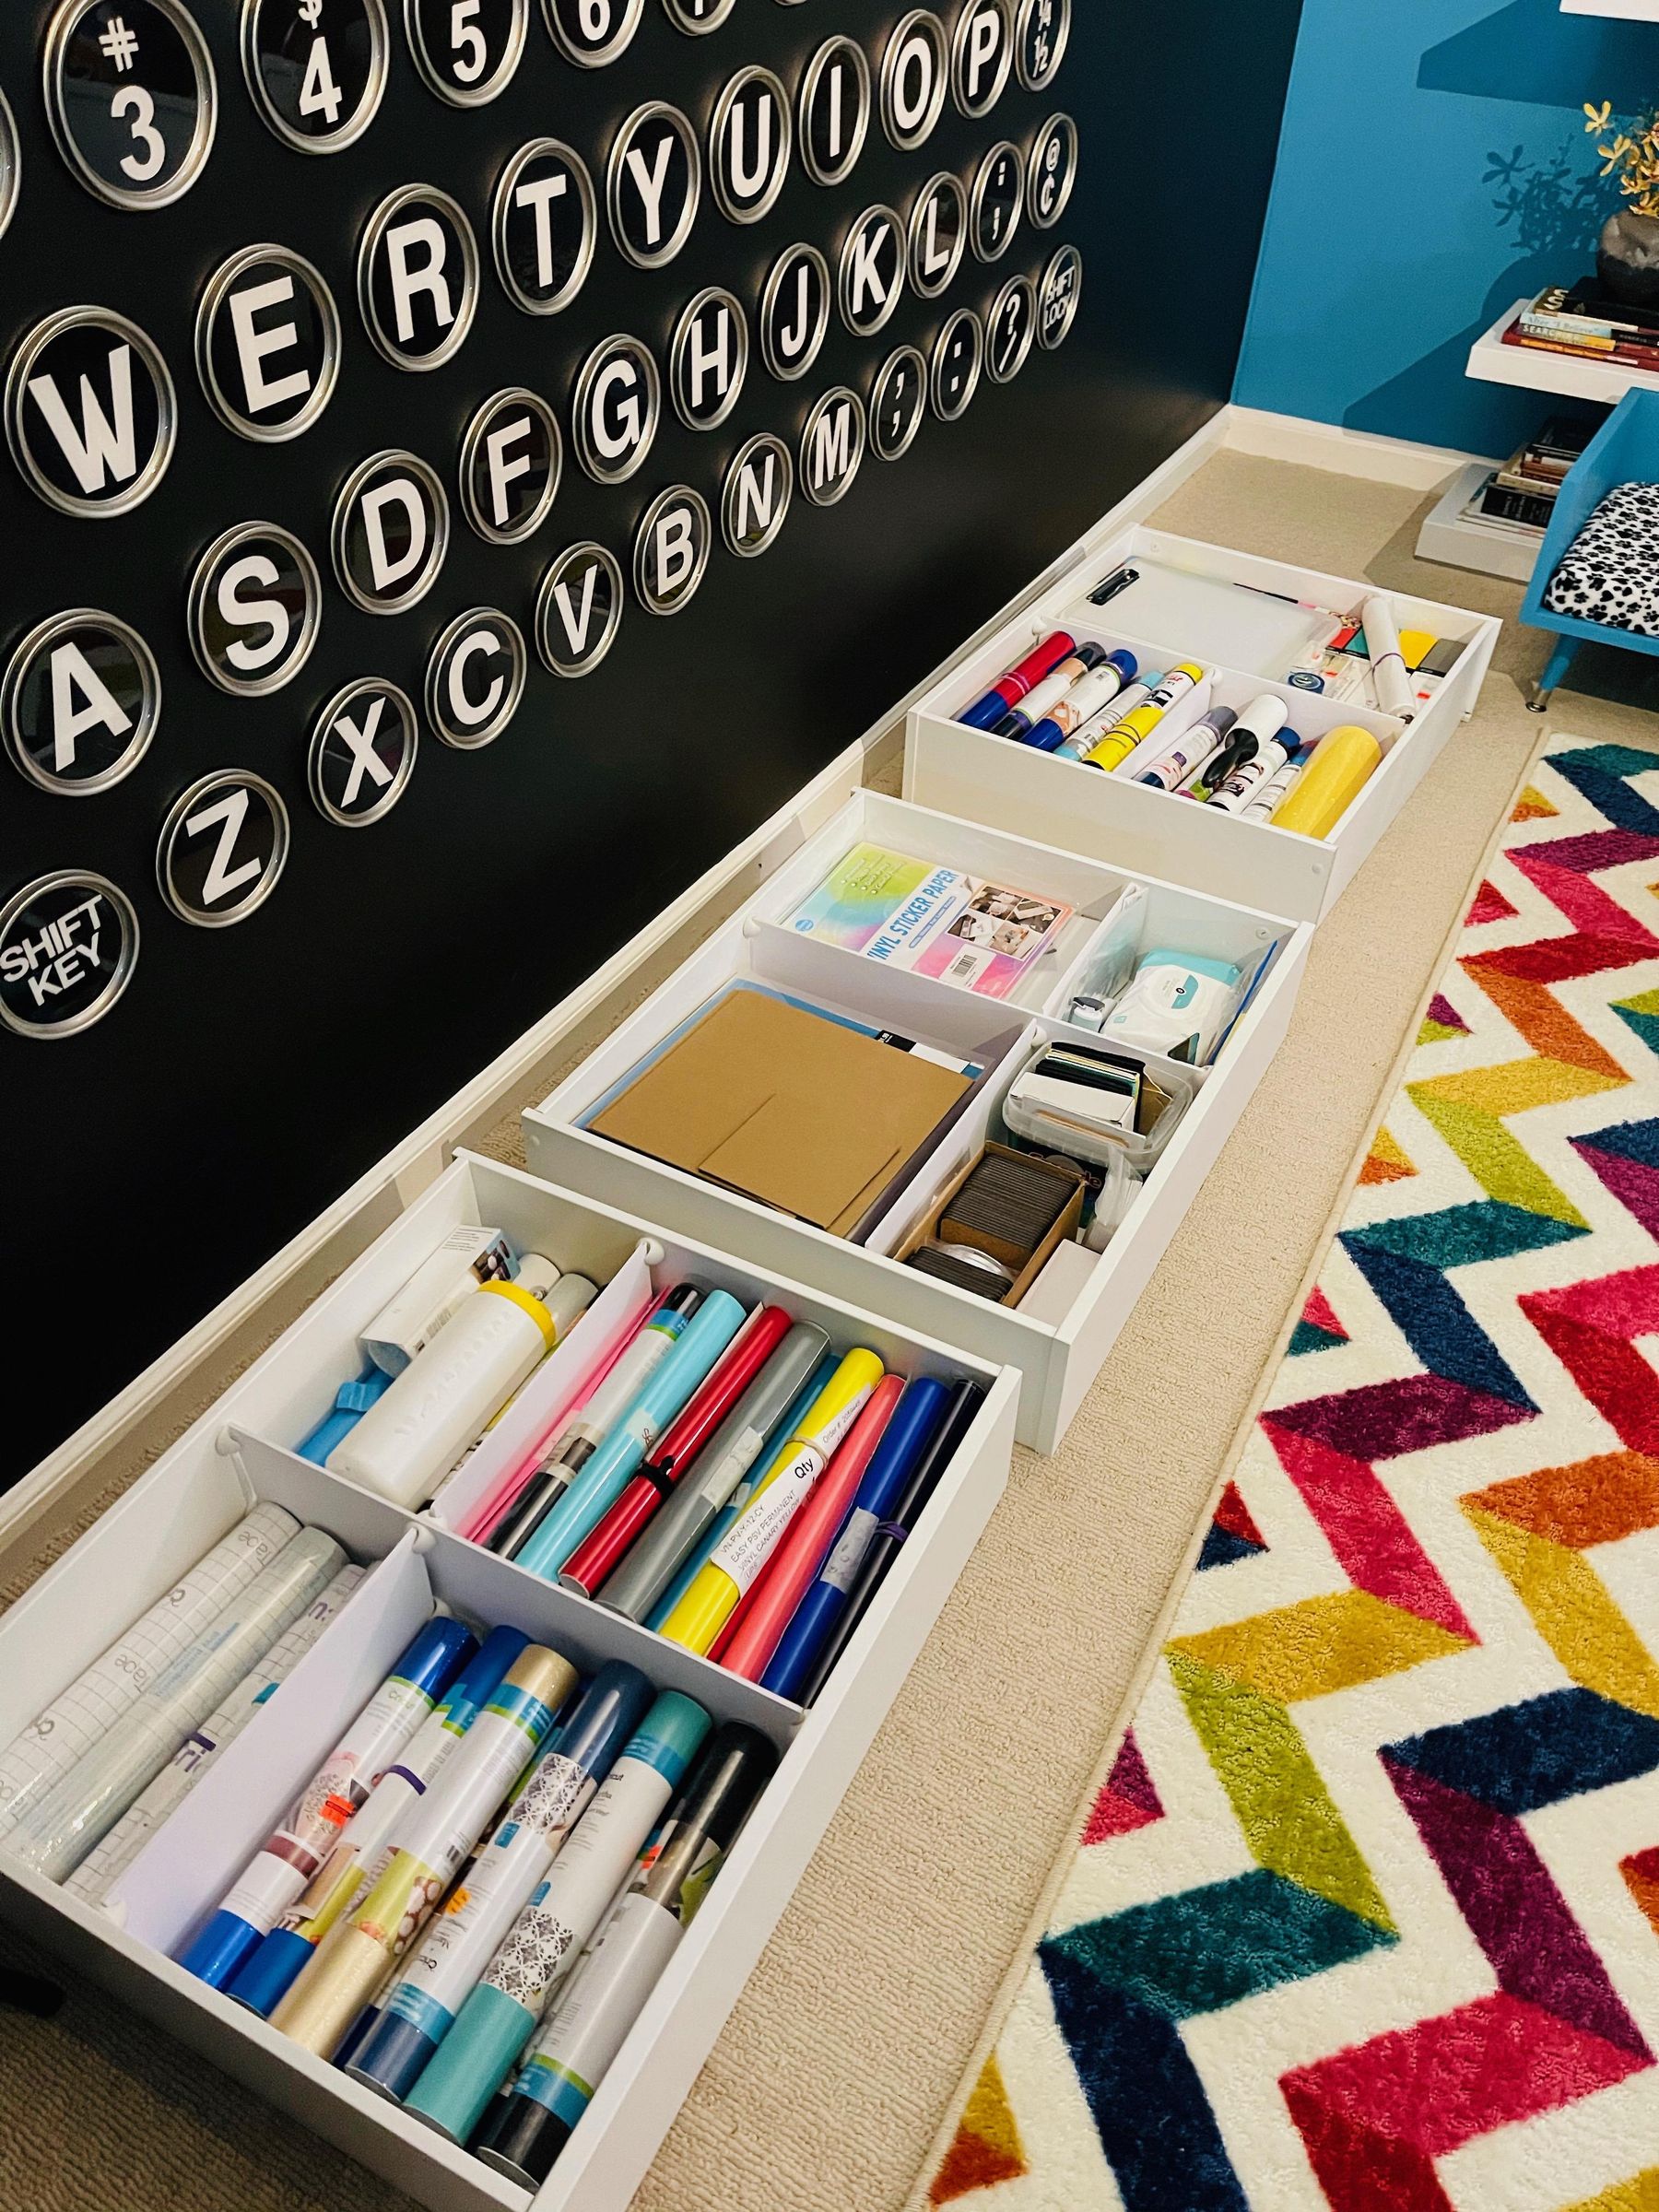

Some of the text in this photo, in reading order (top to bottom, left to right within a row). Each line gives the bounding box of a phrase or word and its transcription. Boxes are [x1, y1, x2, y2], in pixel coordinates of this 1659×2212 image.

[99, 18, 138, 72] #
[300, 37, 342, 123] 4
[452, 3, 486, 81] 5
[893, 38, 923, 130] O
[969, 10, 999, 97] P
[112, 86, 165, 181] 3
[732, 95, 771, 197] U
[830, 65, 841, 157] I
[516, 174, 566, 287] T
[626, 136, 673, 244] Y
[925, 197, 949, 275] L
[387, 218, 454, 342] R
[782, 265, 807, 356] J
[853, 223, 892, 314] K
[229, 276, 310, 413] E
[690, 309, 729, 407] H
[29, 345, 135, 493] W
[591, 359, 641, 458] G
[815, 403, 851, 489] M
[488, 417, 530, 525] F
[737, 454, 775, 540] N
[361, 479, 426, 590] D
[657, 509, 693, 595] B
[218, 556, 288, 669] S
[554, 564, 597, 655] V
[52, 642, 132, 771] A
[449, 631, 503, 724] C
[334, 698, 394, 807] X
[186, 789, 261, 904] Z
[0, 894, 104, 983] SHIFT
[889, 897, 934, 936] STICKER
[922, 869, 959, 899] PAPER
[28, 934, 102, 1006] KEY
[794, 1458, 814, 1479] Qty
[730, 1542, 749, 1562] EASY
[747, 1528, 762, 1544] PSV
[759, 1488, 796, 1531] PERMANENT
[737, 1549, 758, 1571] VINYL
[756, 1523, 780, 1552] CANARY
